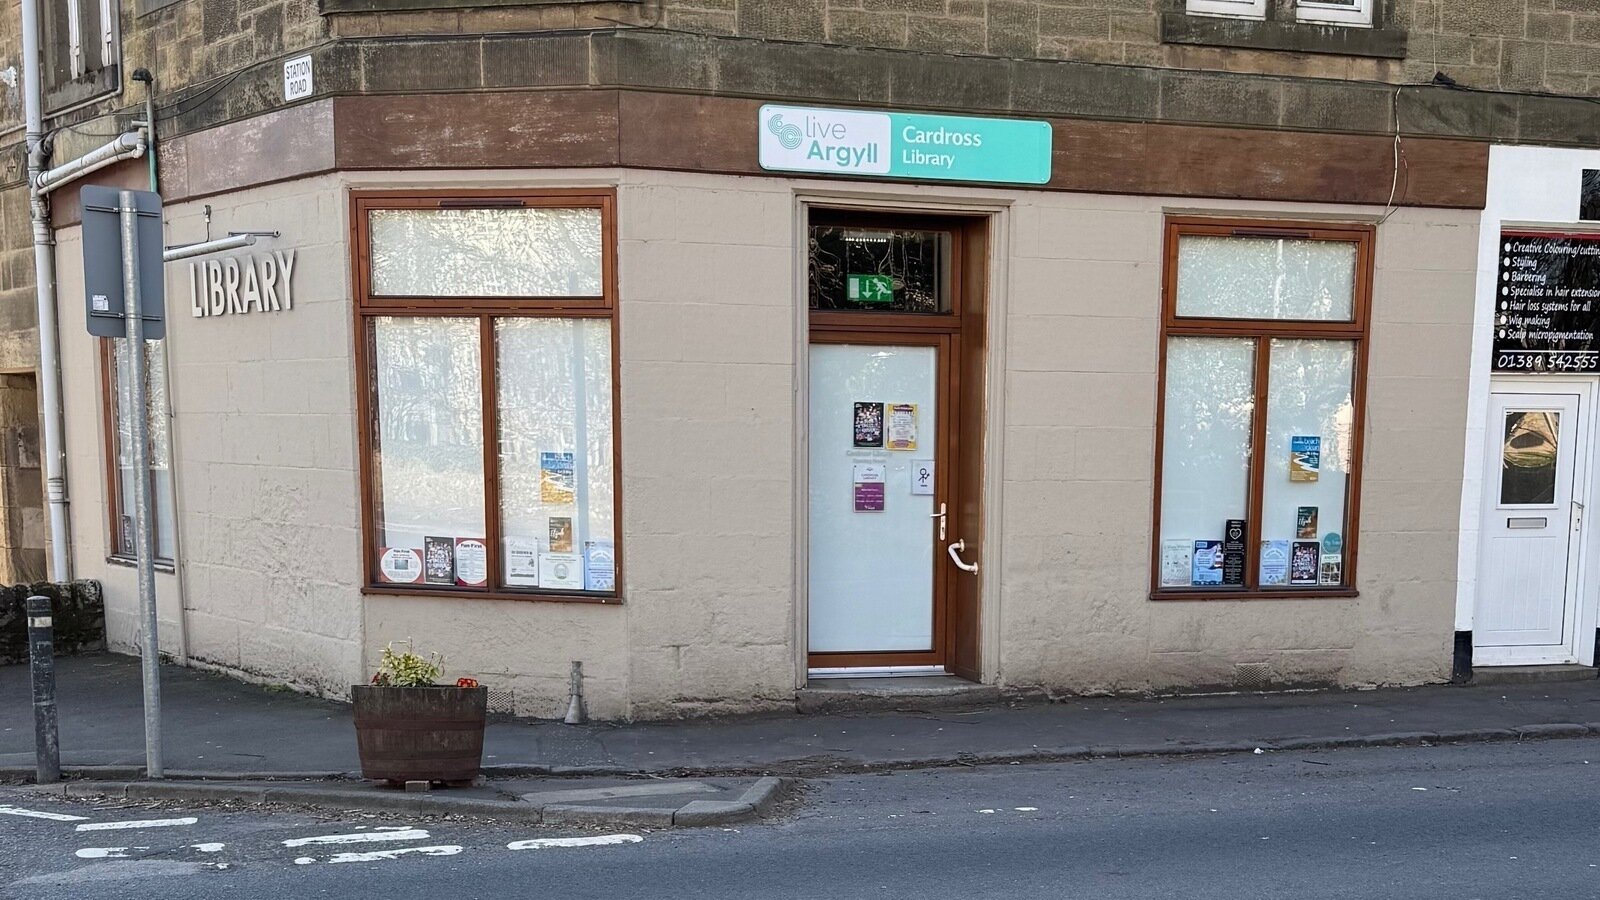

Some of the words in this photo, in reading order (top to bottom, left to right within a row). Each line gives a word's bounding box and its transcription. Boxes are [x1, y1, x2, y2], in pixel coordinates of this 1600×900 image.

[286, 61, 310, 80] STATION
[290, 79, 307, 96] ROAD
[806, 116, 847, 140] live
[902, 126, 983, 148] Cardross
[806, 140, 878, 167] Argyll
[902, 149, 956, 169] Library
[1513, 241, 1542, 253] Creative
[1512, 256, 1538, 271] Styling
[189, 248, 296, 317] LIBRARY
[1511, 271, 1547, 286] Barbering
[1510, 285, 1544, 299] Specialise
[1545, 285, 1553, 297] in
[1555, 285, 1570, 298] hair
[1509, 299, 1526, 311] Hair
[1527, 299, 1540, 311] loss
[1541, 300, 1569, 314] systems
[1570, 299, 1581, 311] for
[1582, 300, 1592, 312] all
[1508, 314, 1523, 328] Wig
[1524, 314, 1551, 329] making
[1507, 328, 1527, 343] Scalp
[1528, 327, 1594, 343] micropigmentation
[1498, 354, 1543, 368] 01389
[1547, 355, 1599, 369] 542555
